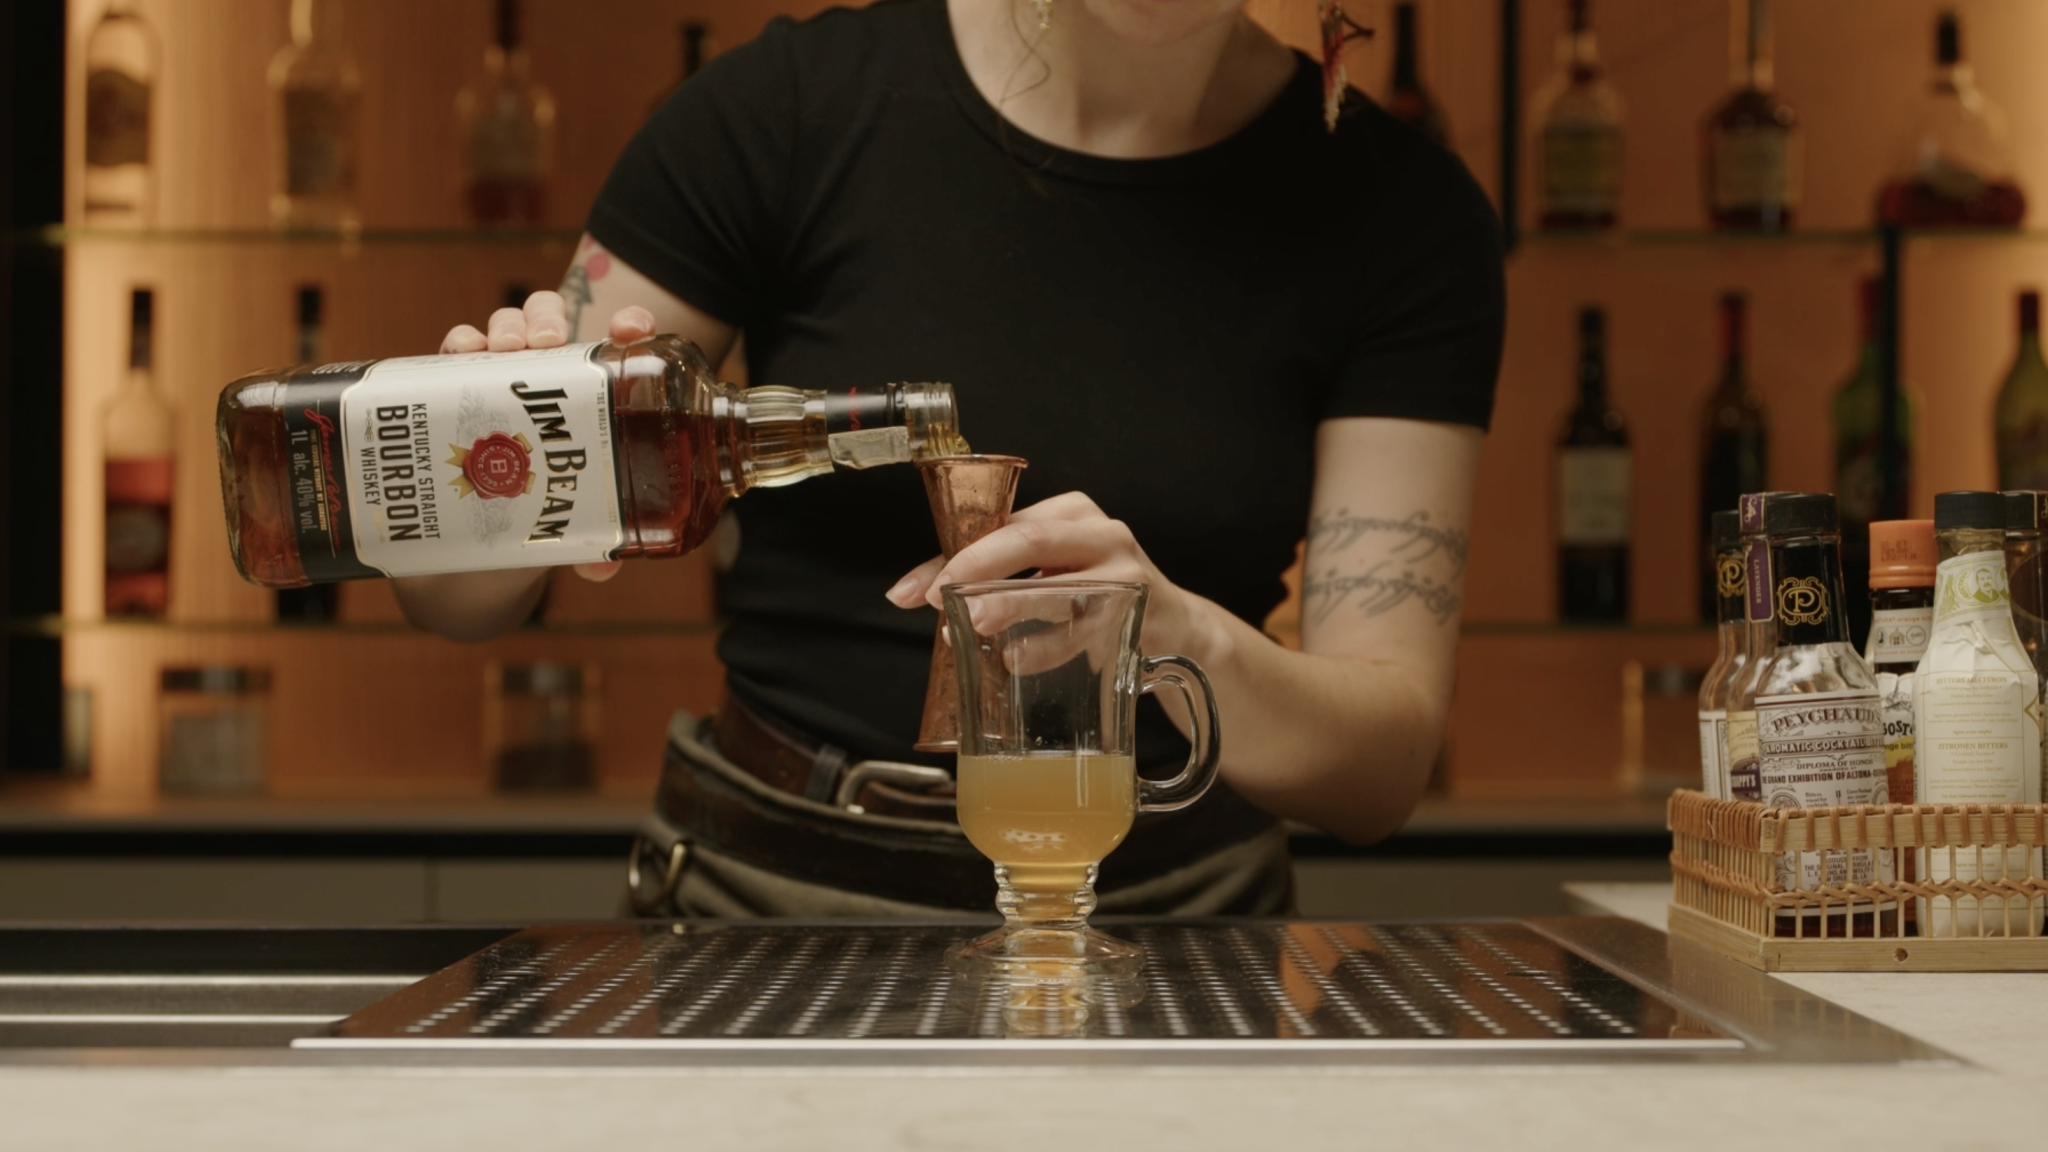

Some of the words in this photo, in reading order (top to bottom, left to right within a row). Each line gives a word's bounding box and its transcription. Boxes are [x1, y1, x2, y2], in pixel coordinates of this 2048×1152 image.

[509, 380, 573, 444] JIM
[290, 430, 309, 445] 1L
[411, 403, 432, 472] KENTUCKY
[293, 453, 311, 475] alc.
[477, 445, 496, 470] SINCE
[502, 446, 516, 458] JIM
[360, 447, 381, 506] WHISKEY
[376, 404, 423, 542] BOURBON
[505, 460, 520, 485] BEAM
[296, 477, 315, 508] 40%
[523, 446, 587, 544] BEAM
[418, 477, 441, 539] STRAIGHT
[299, 510, 318, 534] vol.
[1753, 559, 1762, 604] LAVENDER
[1765, 742, 1814, 755] AROMATIC
[1815, 738, 1866, 751] COCKTAIL
[1796, 762, 1836, 770] DIPLOMA
[1837, 760, 1848, 768] OF
[1849, 759, 1874, 767] HONOR
[1767, 774, 1786, 784] GRAND
[1788, 772, 1833, 783] EXHIBITION
[1836, 771, 1847, 780] OF
